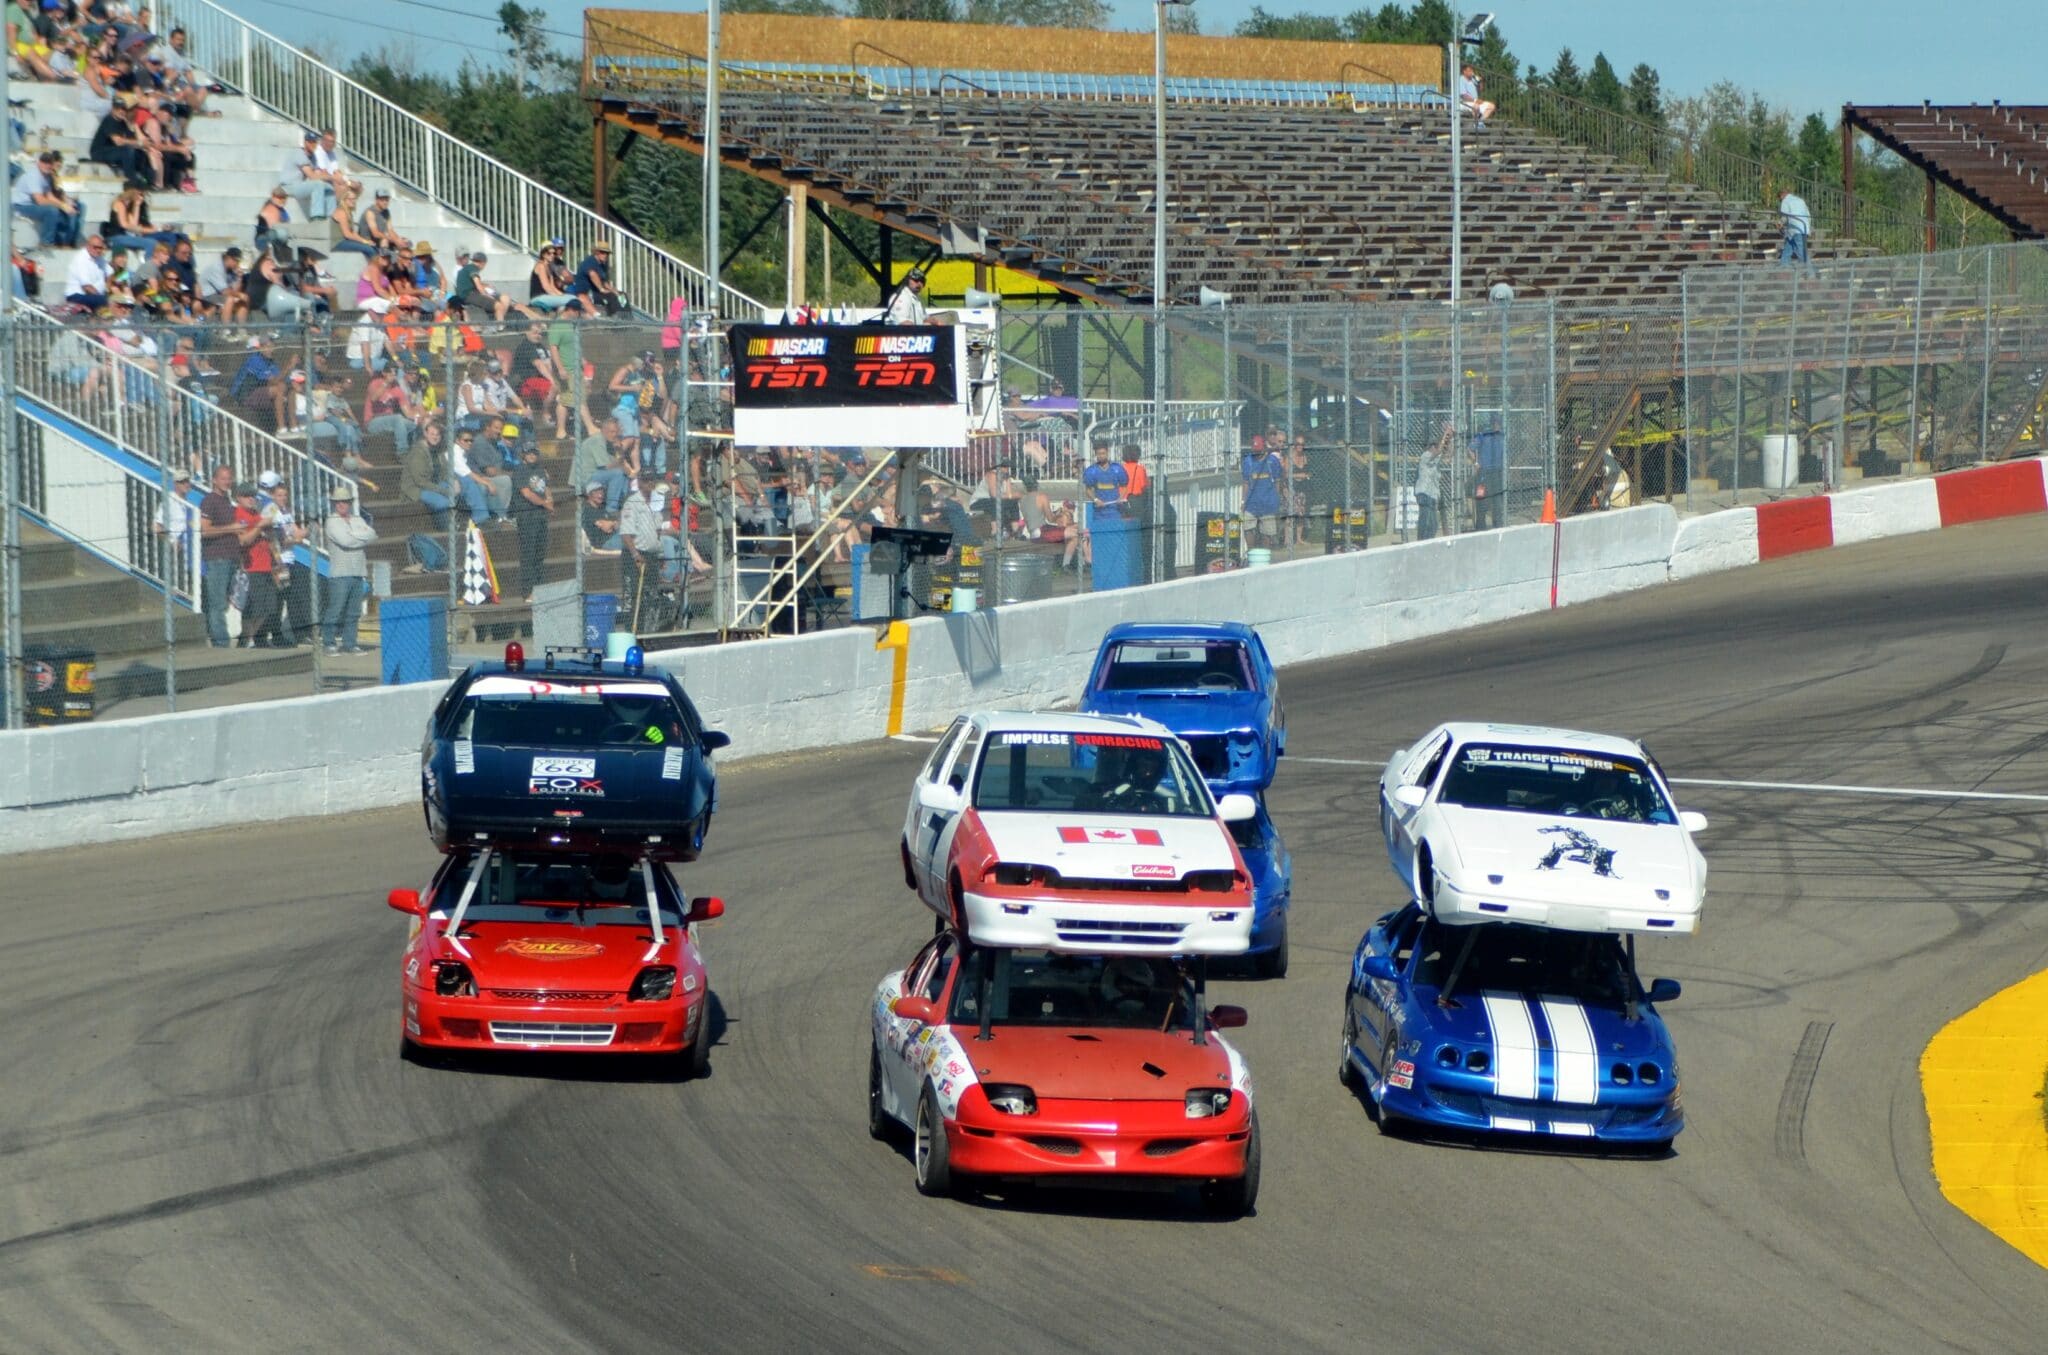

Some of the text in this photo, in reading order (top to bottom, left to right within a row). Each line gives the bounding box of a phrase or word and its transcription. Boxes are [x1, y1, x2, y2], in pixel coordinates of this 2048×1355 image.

[772, 338, 826, 355] NASCAR
[879, 336, 933, 354] NASCAR
[780, 357, 794, 365] ON
[887, 355, 901, 363] ON
[747, 362, 828, 388] TSN
[854, 362, 935, 387] TSN
[1002, 733, 1162, 750] IMPULSE SIMRACING
[545, 764, 583, 773] 66
[1494, 752, 1613, 771] TRANSFORMERS
[529, 778, 602, 791] FOX
